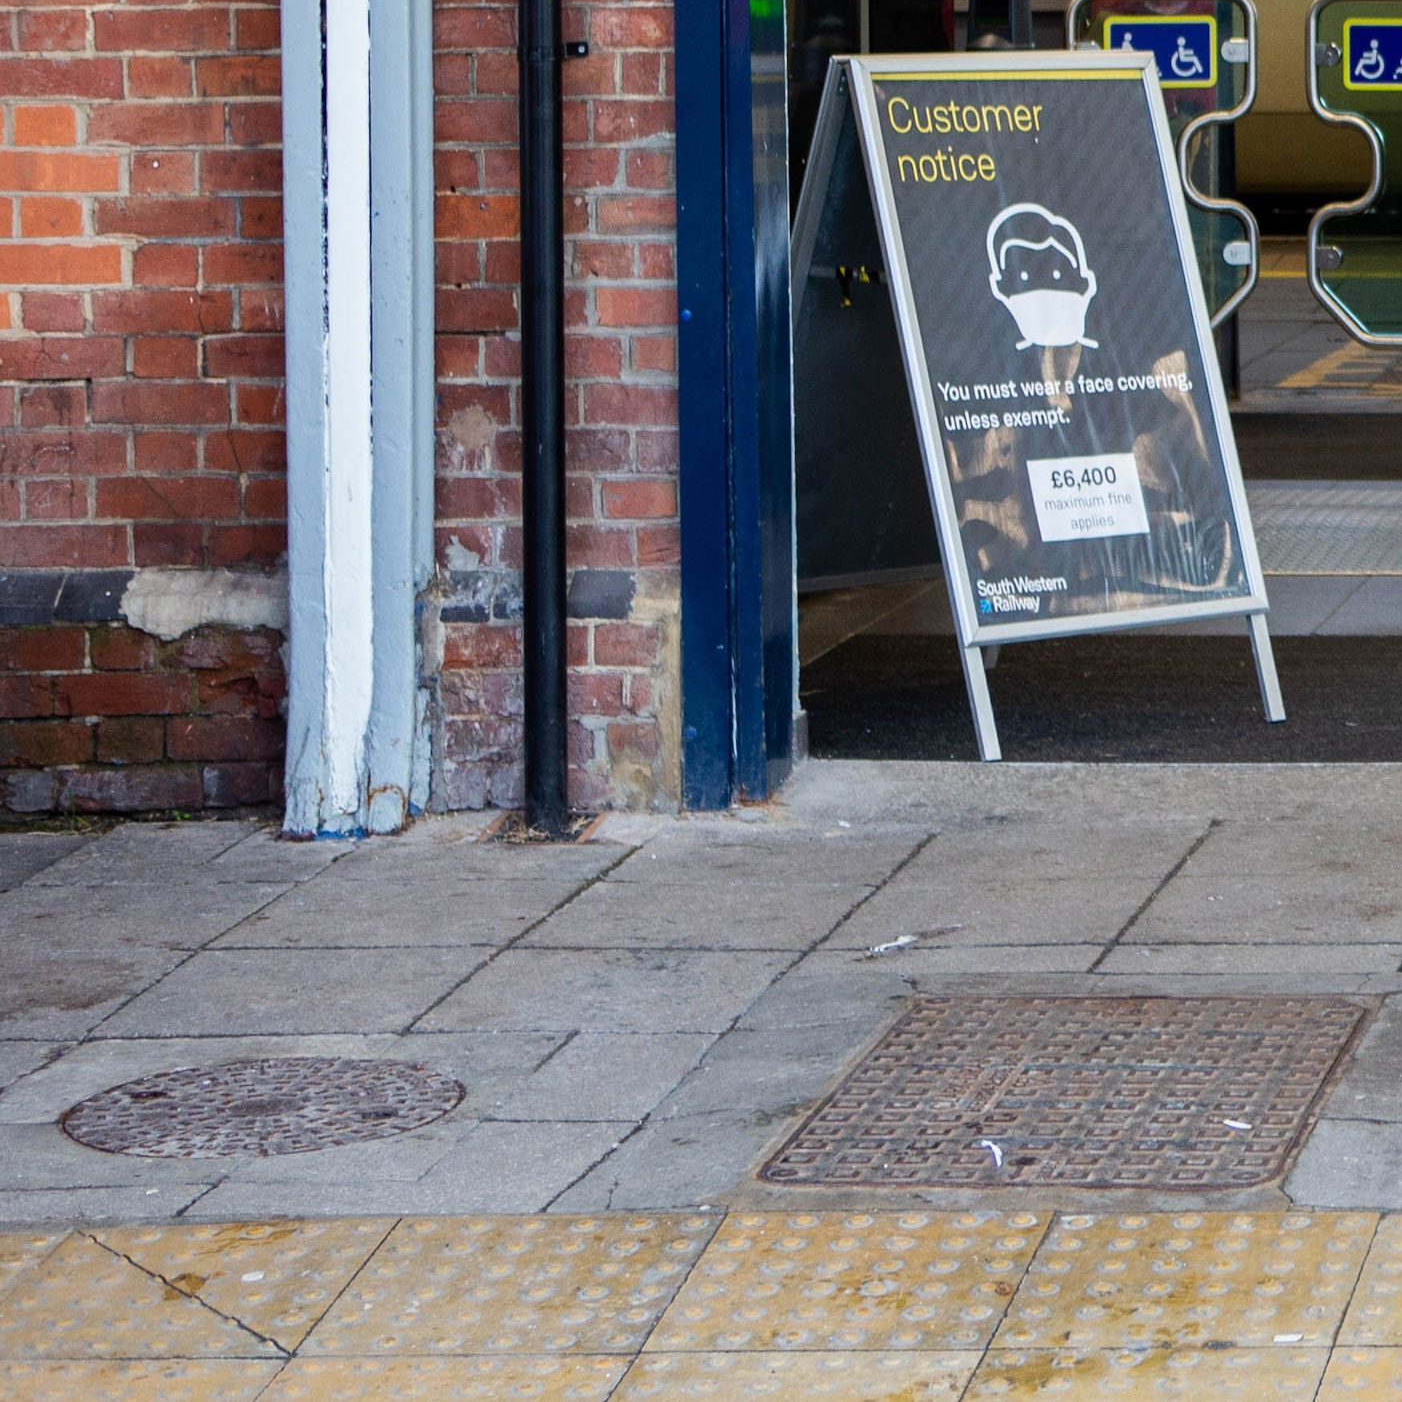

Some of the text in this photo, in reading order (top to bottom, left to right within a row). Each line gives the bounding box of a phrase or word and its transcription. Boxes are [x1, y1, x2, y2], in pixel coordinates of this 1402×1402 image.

[887, 96, 1043, 134] Customer
[897, 145, 996, 183] notice
[938, 370, 1194, 402] You must wear a face covering,
[944, 406, 1071, 431] unless exempt.
[1051, 465, 1117, 491] £6,400
[1044, 491, 1132, 511] maximum fine
[1070, 515, 1115, 534] applies
[976, 574, 1068, 597] South Western
[993, 594, 1041, 614] Railway
